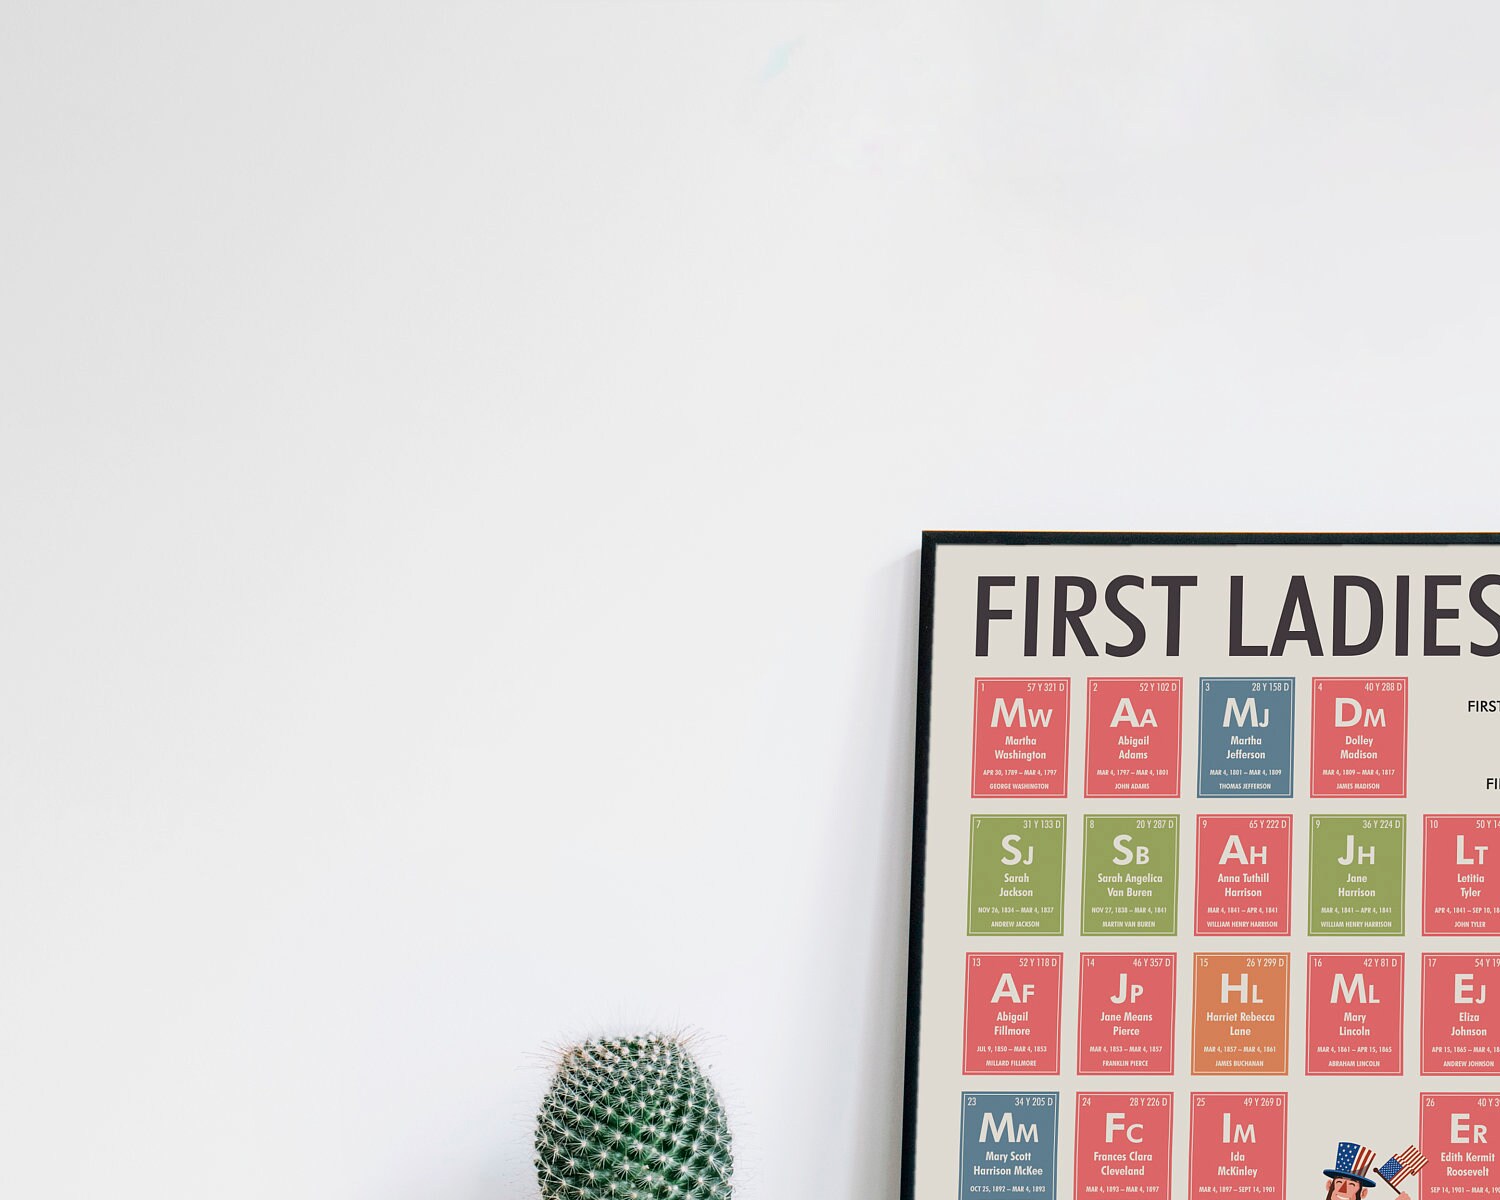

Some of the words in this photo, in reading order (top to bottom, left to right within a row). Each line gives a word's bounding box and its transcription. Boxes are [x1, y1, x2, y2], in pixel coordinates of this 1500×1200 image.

[975, 575, 1198, 657] FIRST
[1005, 735, 1036, 745] Martha
[1118, 735, 1149, 748] Abigail
[1231, 735, 1262, 745] Martha
[1346, 735, 1373, 747] Dolley
[995, 749, 1046, 762] Washington
[1119, 749, 1148, 759] Adams
[1226, 749, 1265, 759] Jefferson
[1340, 749, 1377, 759] Madison
[1004, 873, 1029, 883] Sarah
[1217, 873, 1240, 882] Anna
[1243, 873, 1269, 883] Tuthill
[1346, 873, 1367, 883] Jane
[1457, 873, 1484, 883] Letitia
[999, 887, 1033, 897] Jackson
[1225, 887, 1262, 897] Harrison
[1338, 887, 1376, 897] Harrison
[1460, 887, 1481, 899] Tyler
[996, 1011, 1028, 1024] Abigail
[1207, 1012, 1237, 1021] Harriet
[1240, 1012, 1275, 1021] Rebecca
[1459, 1012, 1479, 1022] Eliza
[994, 1025, 1030, 1035] Fillmore
[1230, 1026, 1251, 1036] Lane
[1451, 1026, 1487, 1036] Johnson
[1231, 1151, 1245, 1161] Ida
[1218, 1165, 1258, 1178] McKinley
